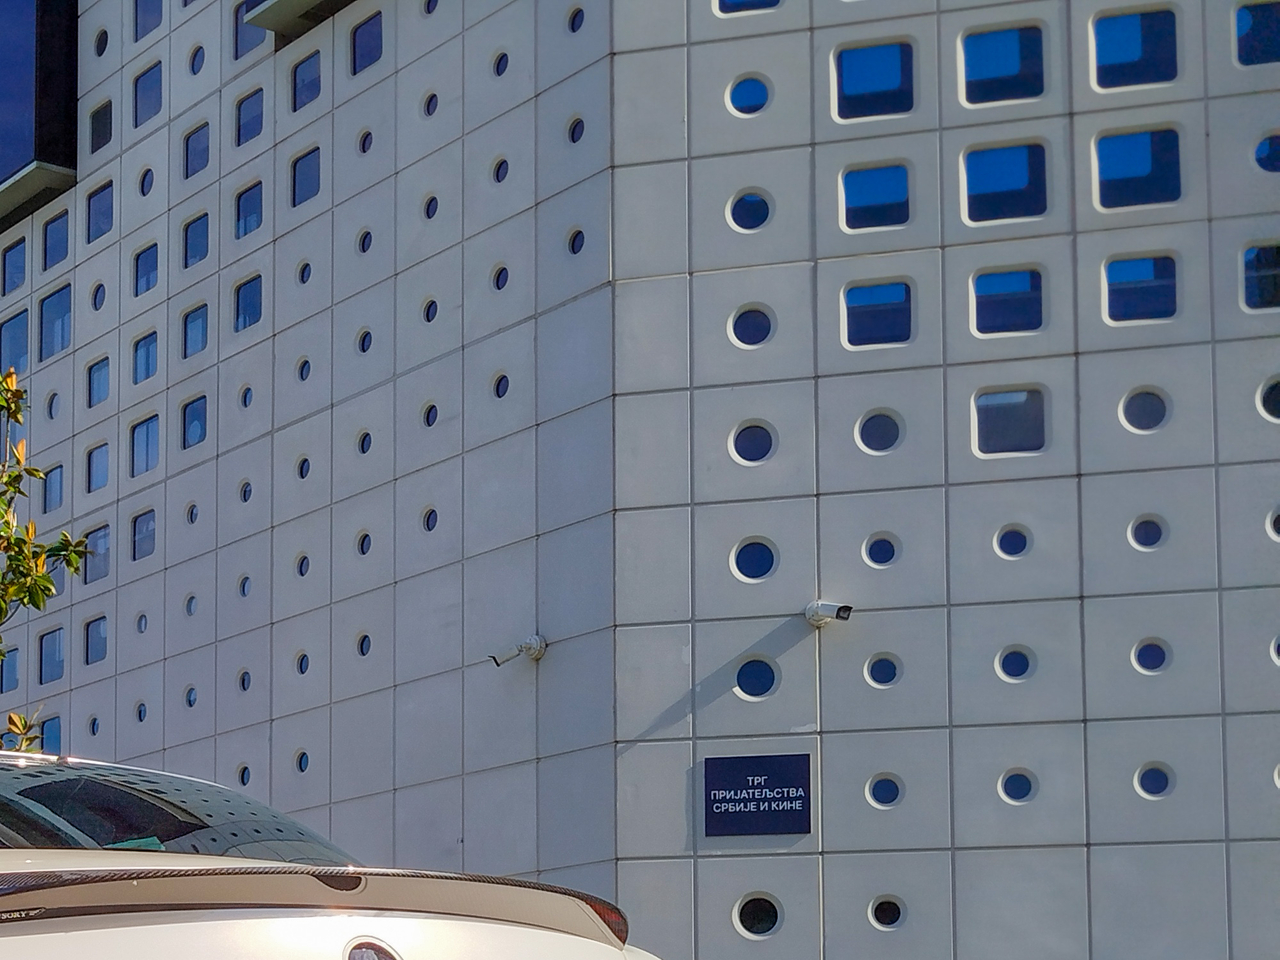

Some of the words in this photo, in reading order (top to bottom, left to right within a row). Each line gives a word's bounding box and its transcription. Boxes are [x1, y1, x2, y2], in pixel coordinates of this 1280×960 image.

[747, 776, 768, 786] ТРГ
[711, 788, 805, 800] ПРИЈАТЕЉСТВА
[713, 802, 757, 813] СРБИЈЕ
[760, 801, 768, 811] И
[771, 800, 802, 811] КИНЕ
